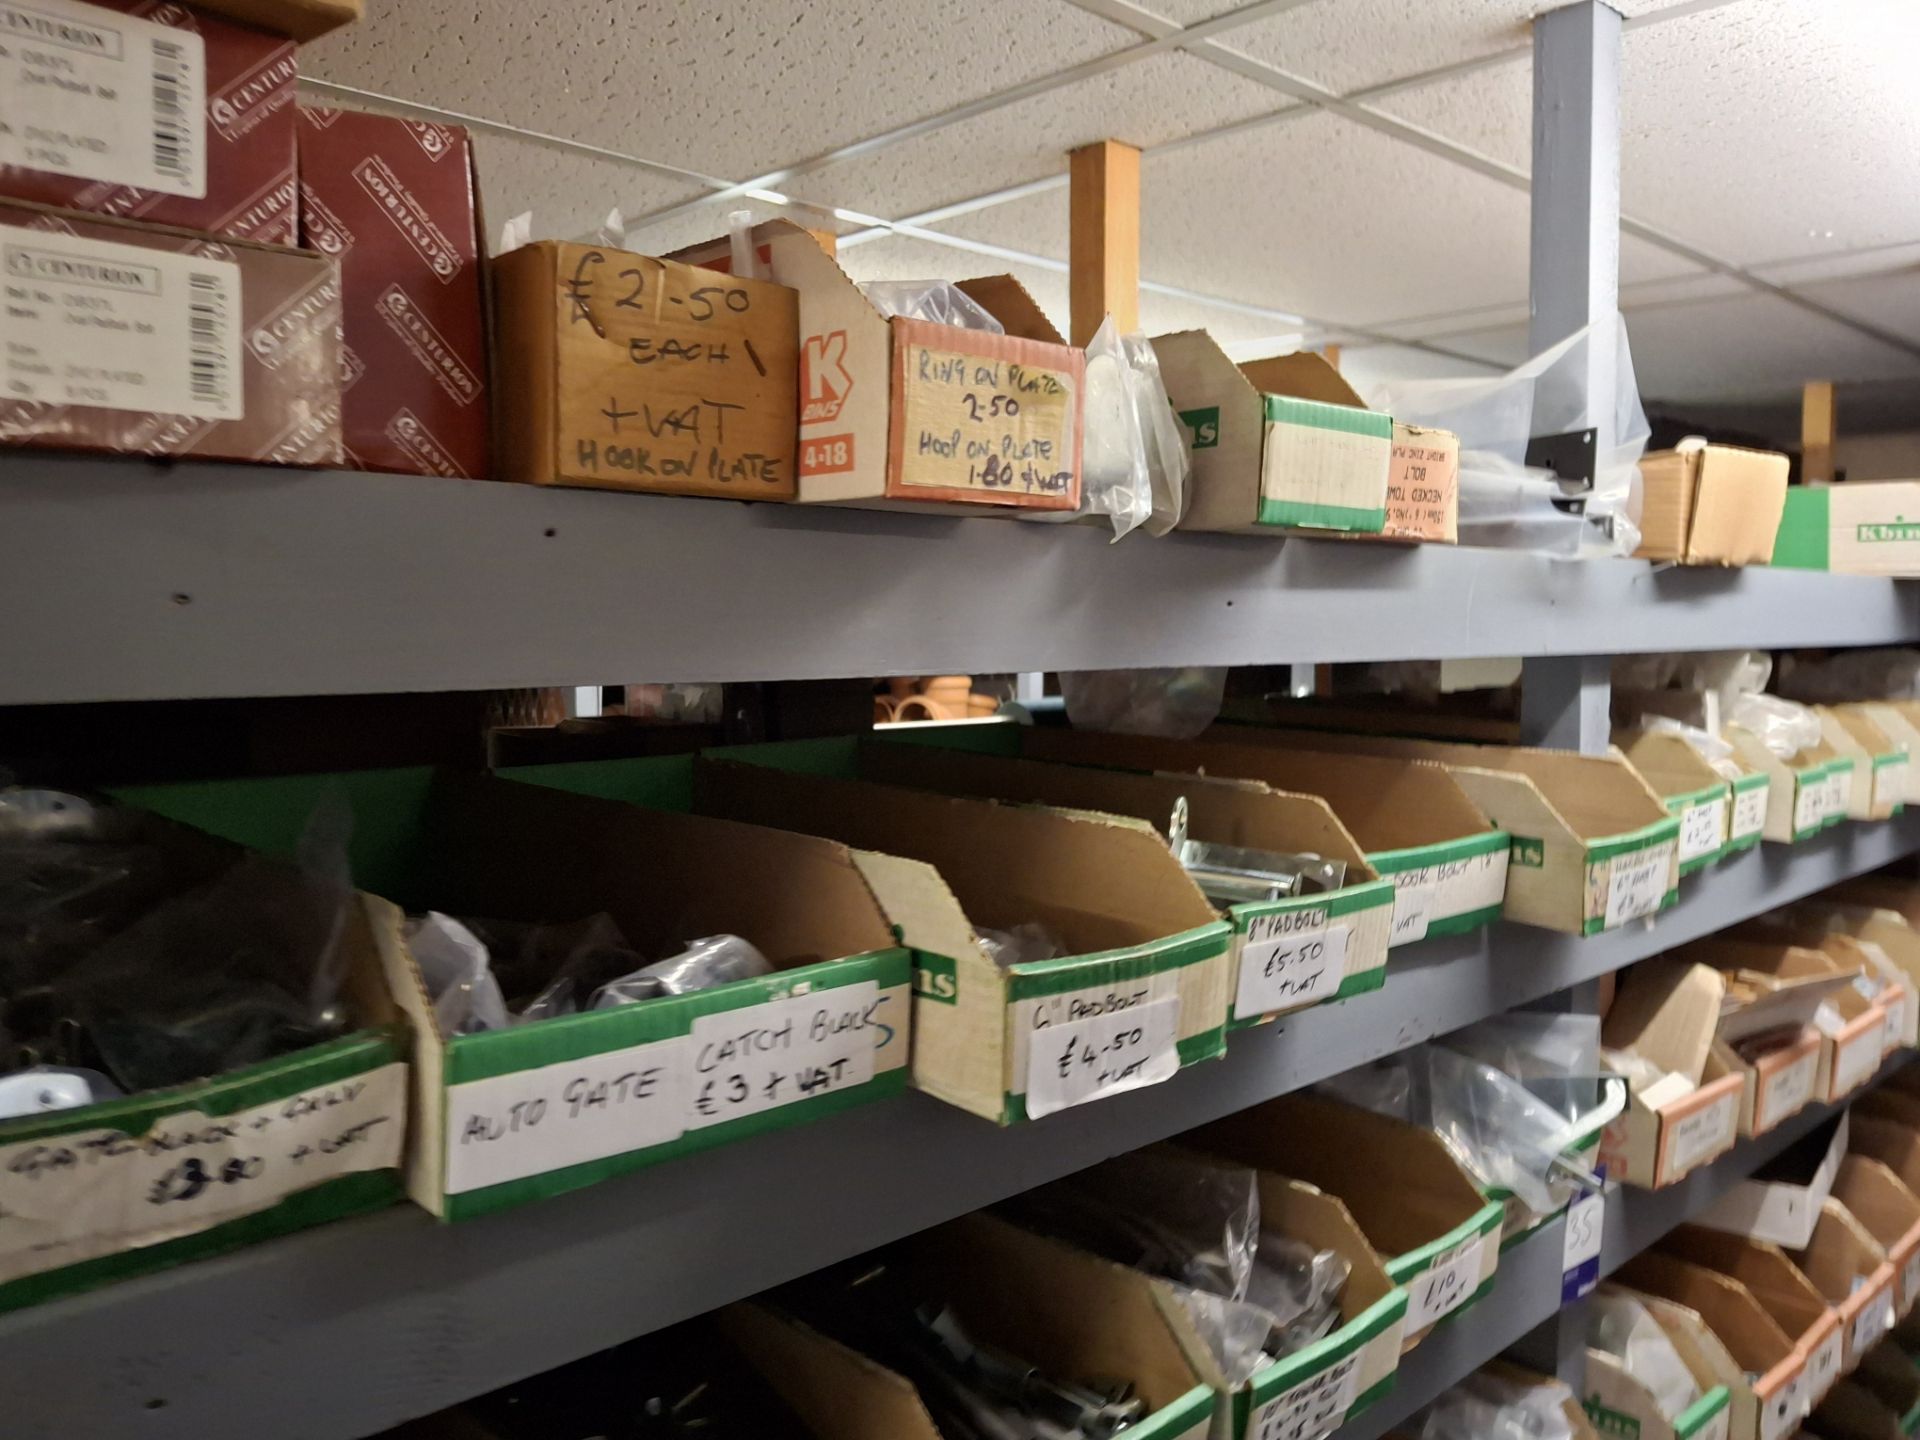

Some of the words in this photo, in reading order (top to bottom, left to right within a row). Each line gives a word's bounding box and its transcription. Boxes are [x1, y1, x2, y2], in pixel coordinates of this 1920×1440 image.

[629, 337, 731, 365] EACH
[919, 349, 965, 387] RING
[974, 362, 999, 389] ON
[1008, 364, 1062, 396] PLATE
[577, 439, 656, 476] HOOK
[661, 457, 698, 477] ON
[708, 447, 783, 482] PLATE
[966, 438, 990, 460] ON
[1001, 434, 1053, 461] PLATE
[1403, 465, 1427, 482] BOLT
[1411, 487, 1443, 504] NECKED
[694, 1017, 792, 1074] CATCH
[460, 1112, 547, 1146] AUTO
[562, 1066, 667, 1119] GATE
